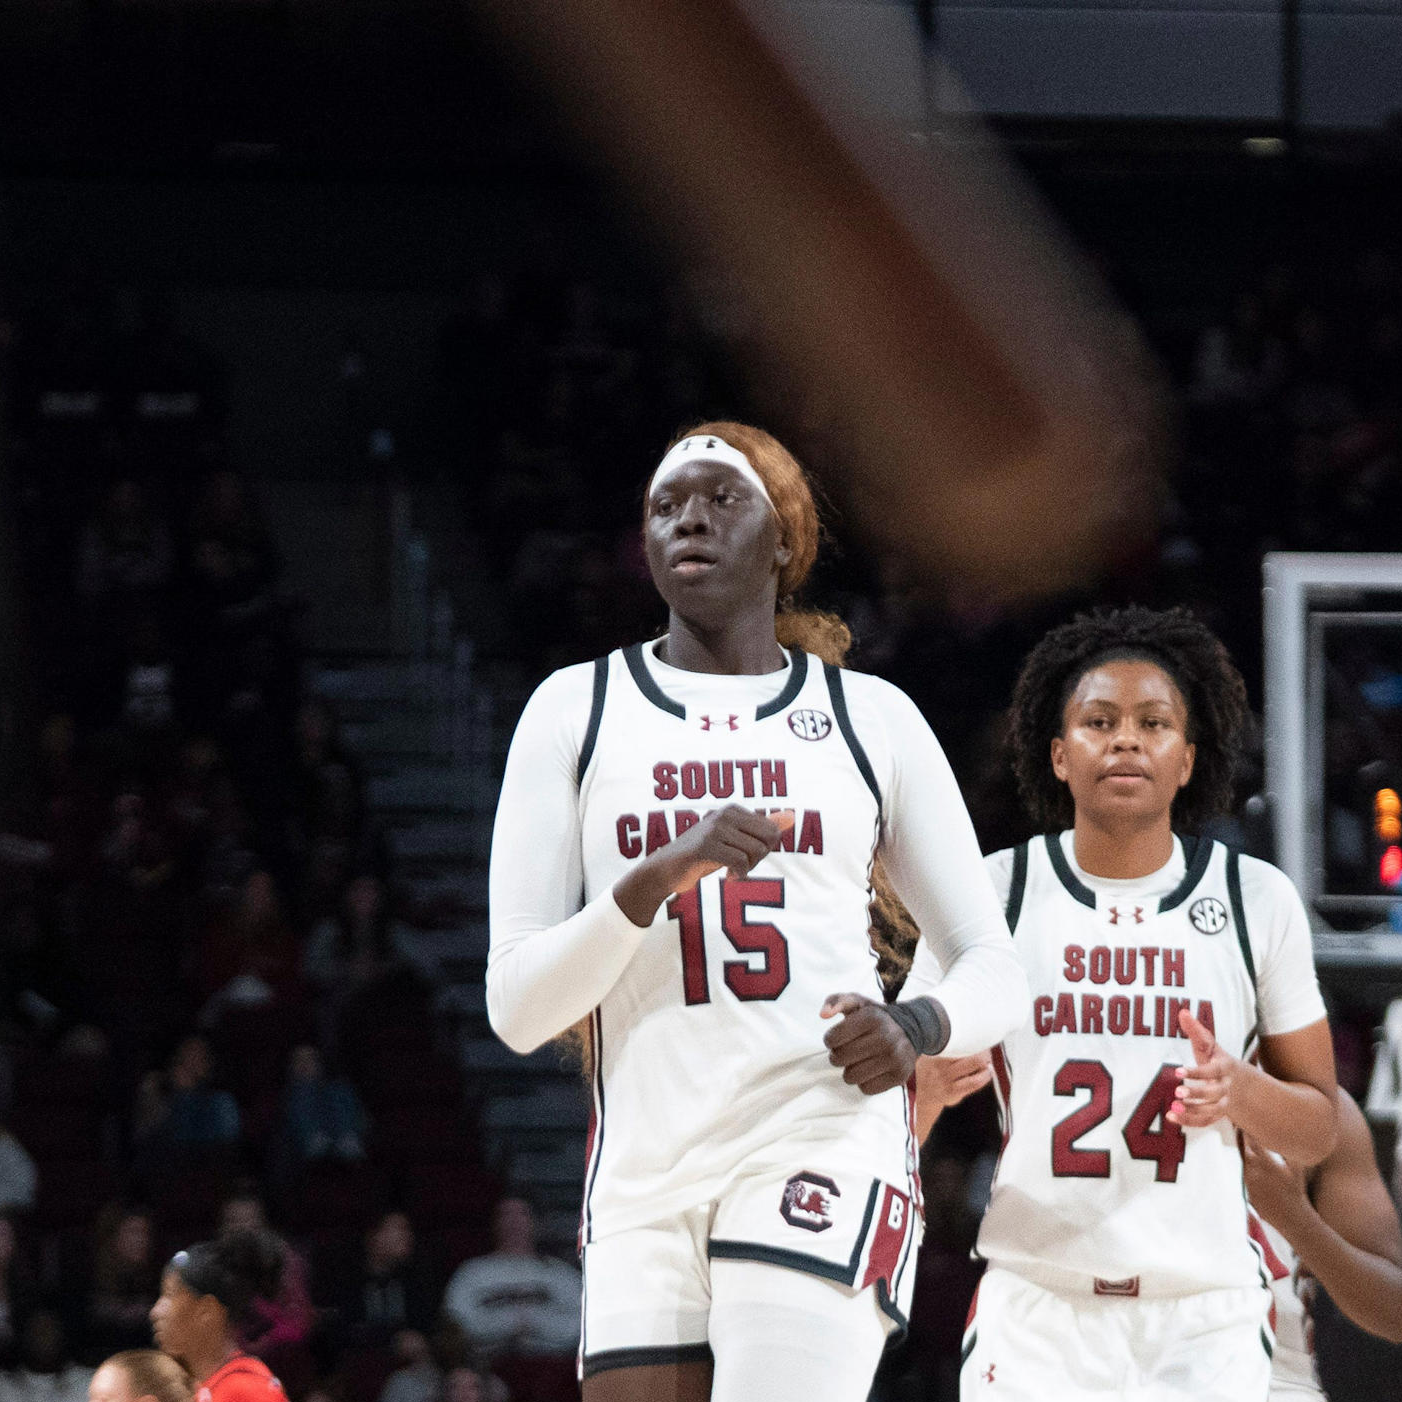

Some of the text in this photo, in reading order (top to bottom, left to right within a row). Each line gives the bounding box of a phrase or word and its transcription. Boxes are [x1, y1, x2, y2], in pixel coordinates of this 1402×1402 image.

[788, 709, 831, 741] SEC
[653, 760, 788, 800] SOUTH
[616, 809, 823, 858] CARNA
[1189, 898, 1228, 934] SEC
[667, 877, 790, 1006] 15
[1063, 944, 1185, 987] SOUTH
[1034, 993, 1215, 1039] CAROLINA
[1051, 1059, 1186, 1183] 24
